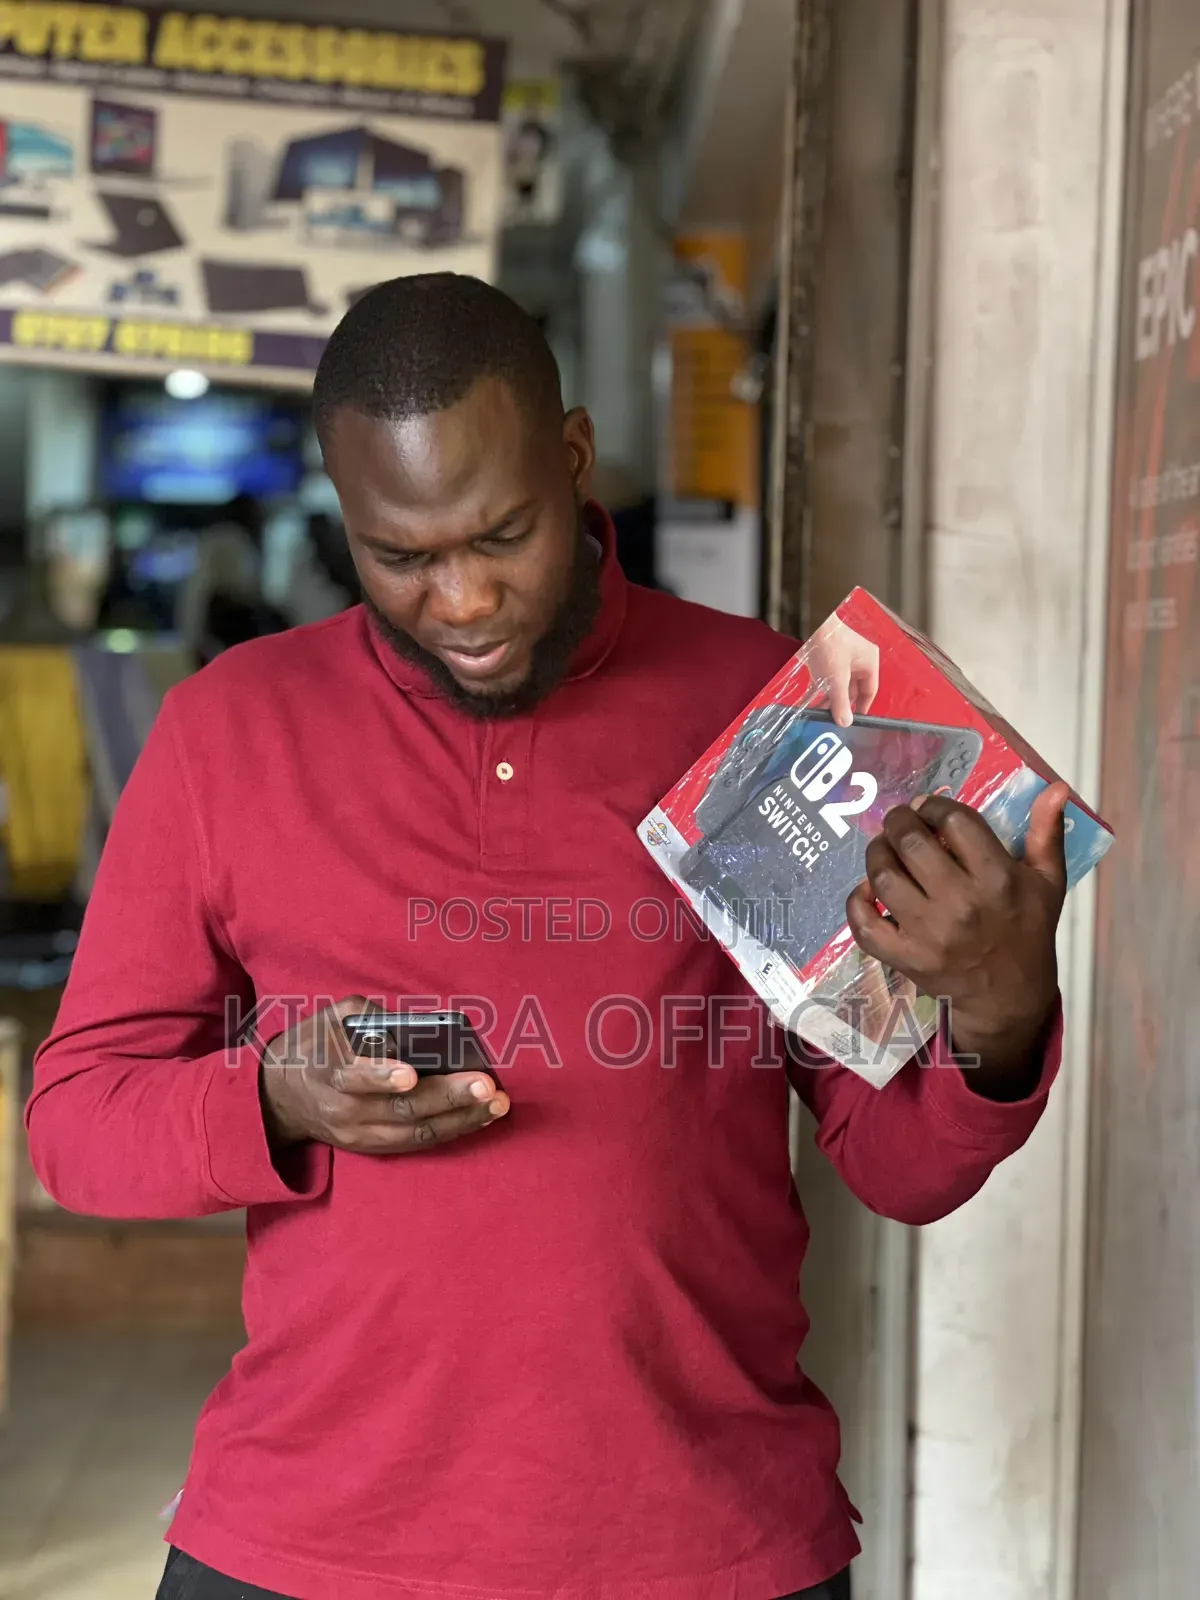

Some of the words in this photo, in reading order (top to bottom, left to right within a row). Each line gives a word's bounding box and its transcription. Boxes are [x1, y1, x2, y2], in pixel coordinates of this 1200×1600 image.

[758, 796, 820, 869] SWITCH
[772, 784, 829, 852] NINTENDO
[819, 771, 878, 839] 2
